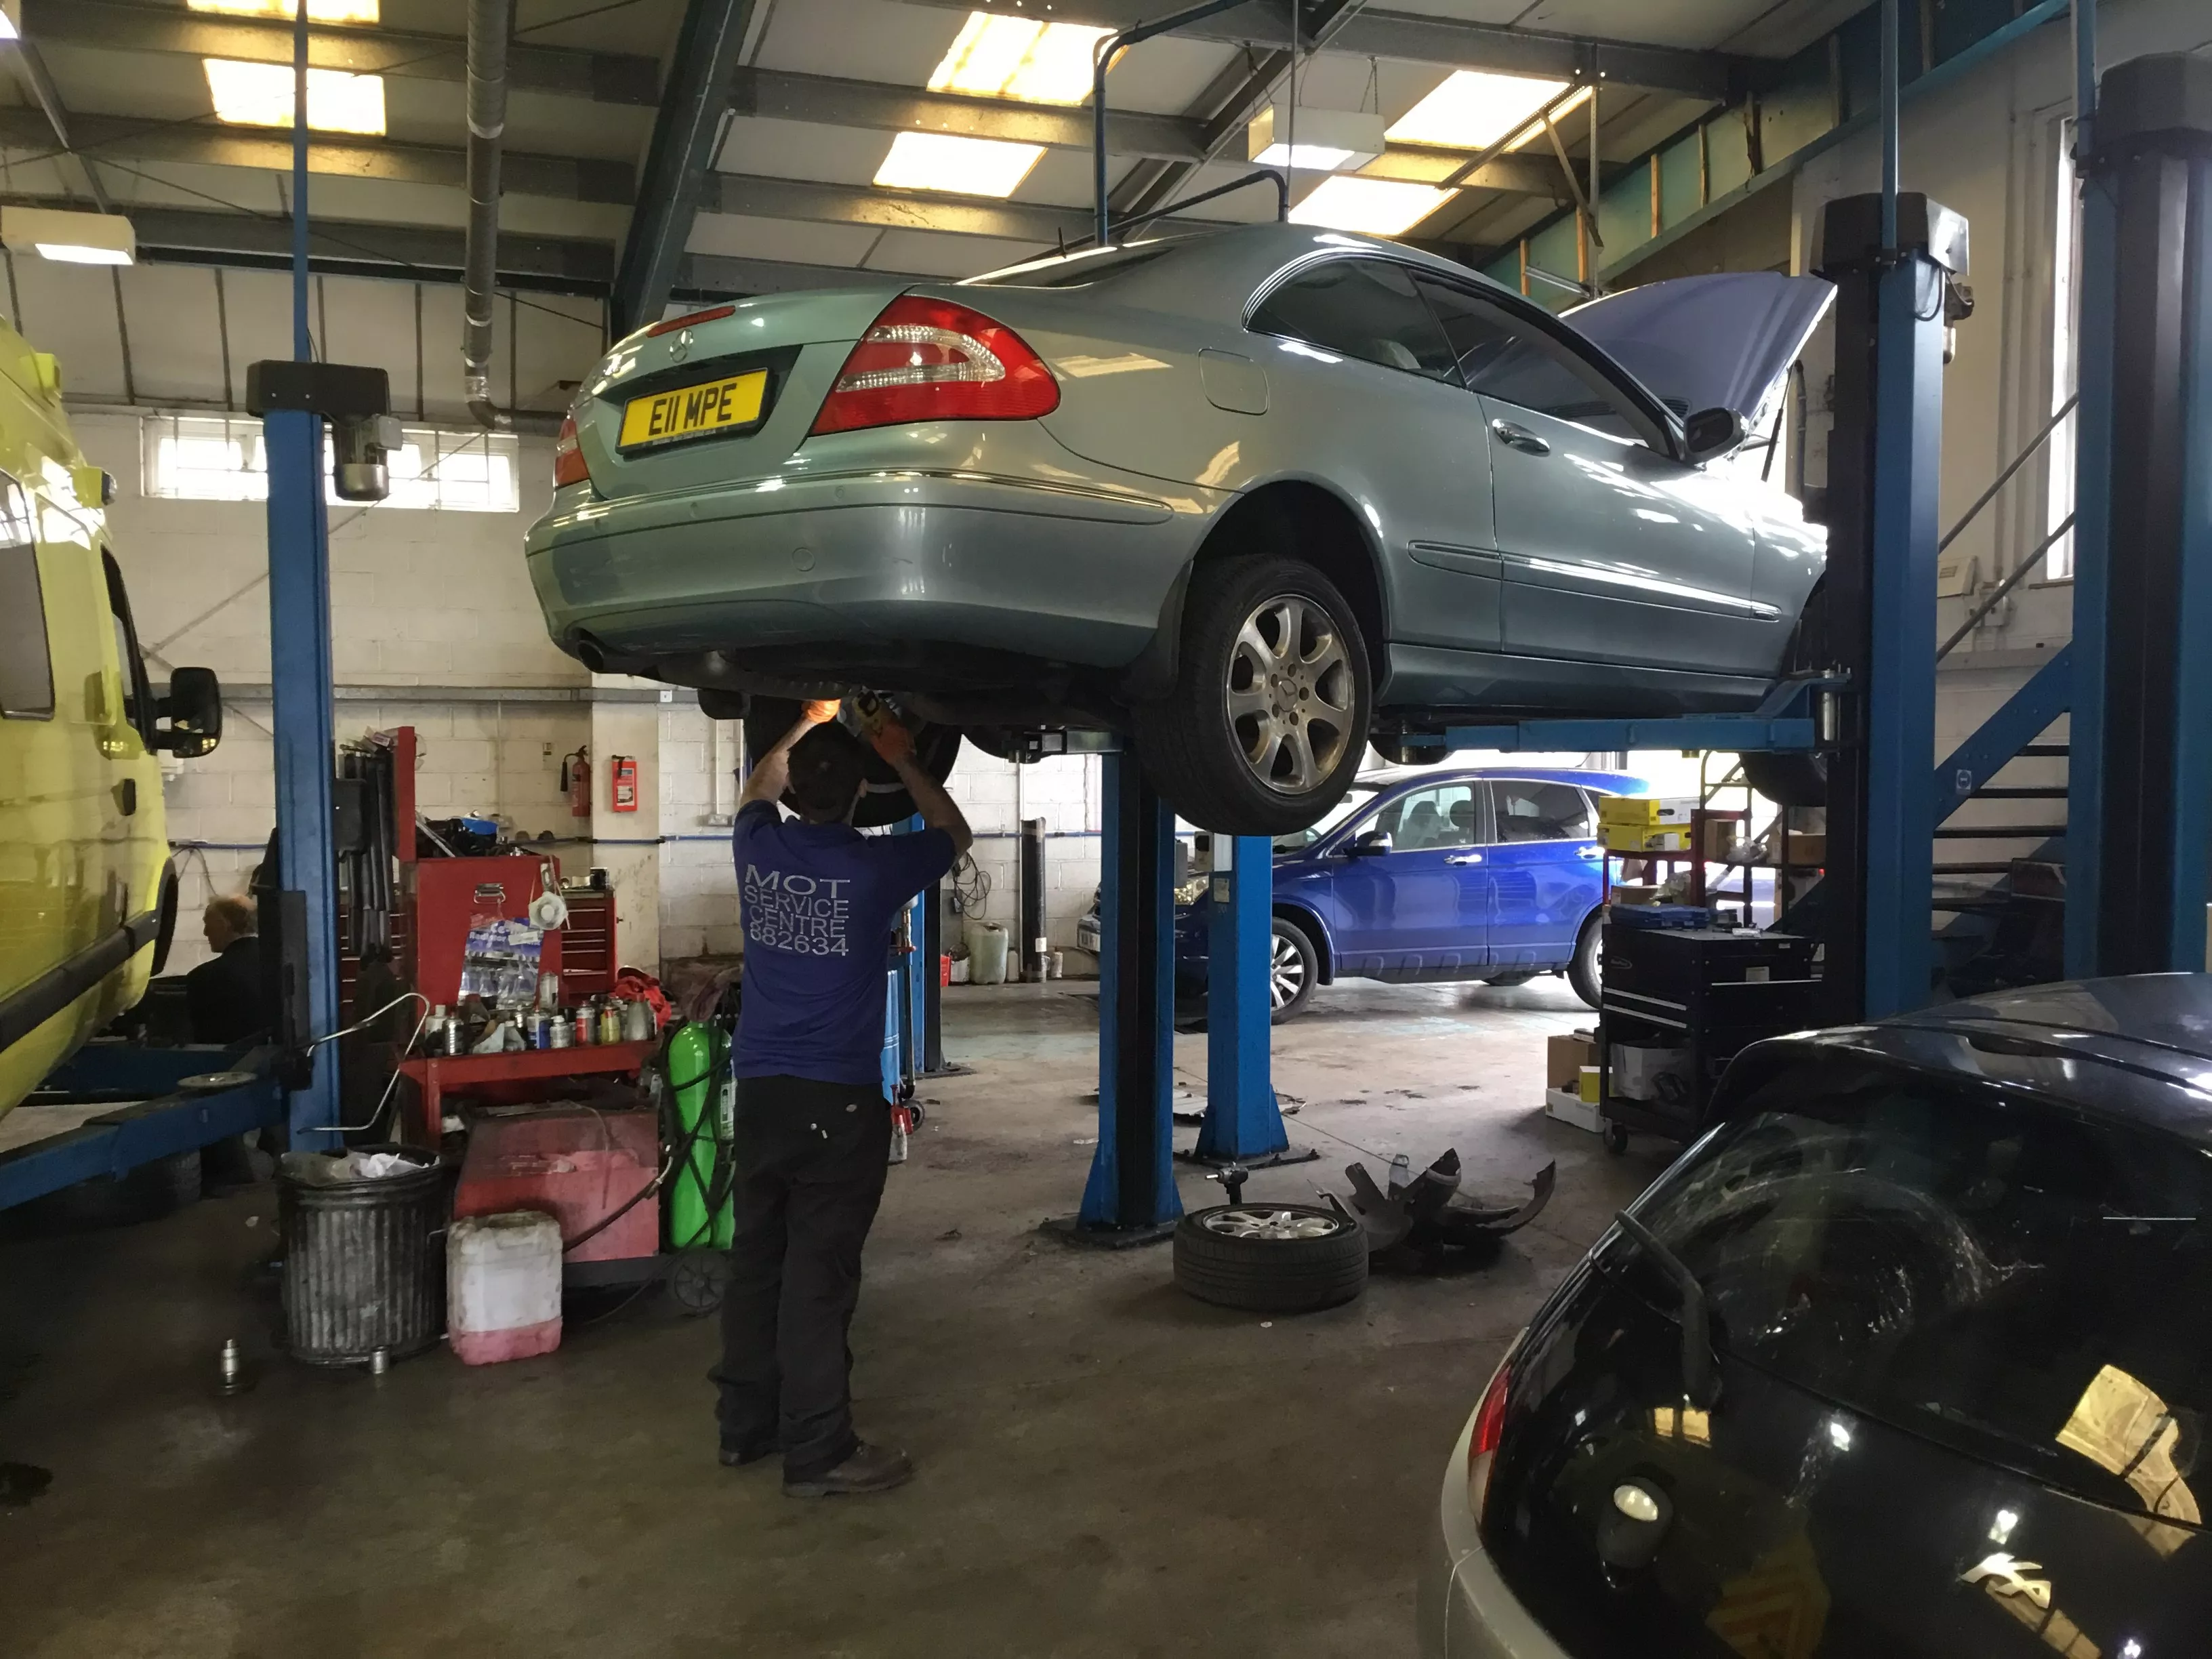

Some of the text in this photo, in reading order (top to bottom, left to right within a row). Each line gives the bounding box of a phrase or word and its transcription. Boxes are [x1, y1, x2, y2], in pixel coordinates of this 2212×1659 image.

[649, 383, 737, 436] E11 MPE
[745, 864, 850, 899] MOT
[744, 885, 849, 919] SERVICE
[749, 905, 846, 938] CENTRE
[750, 922, 849, 956] 882634
